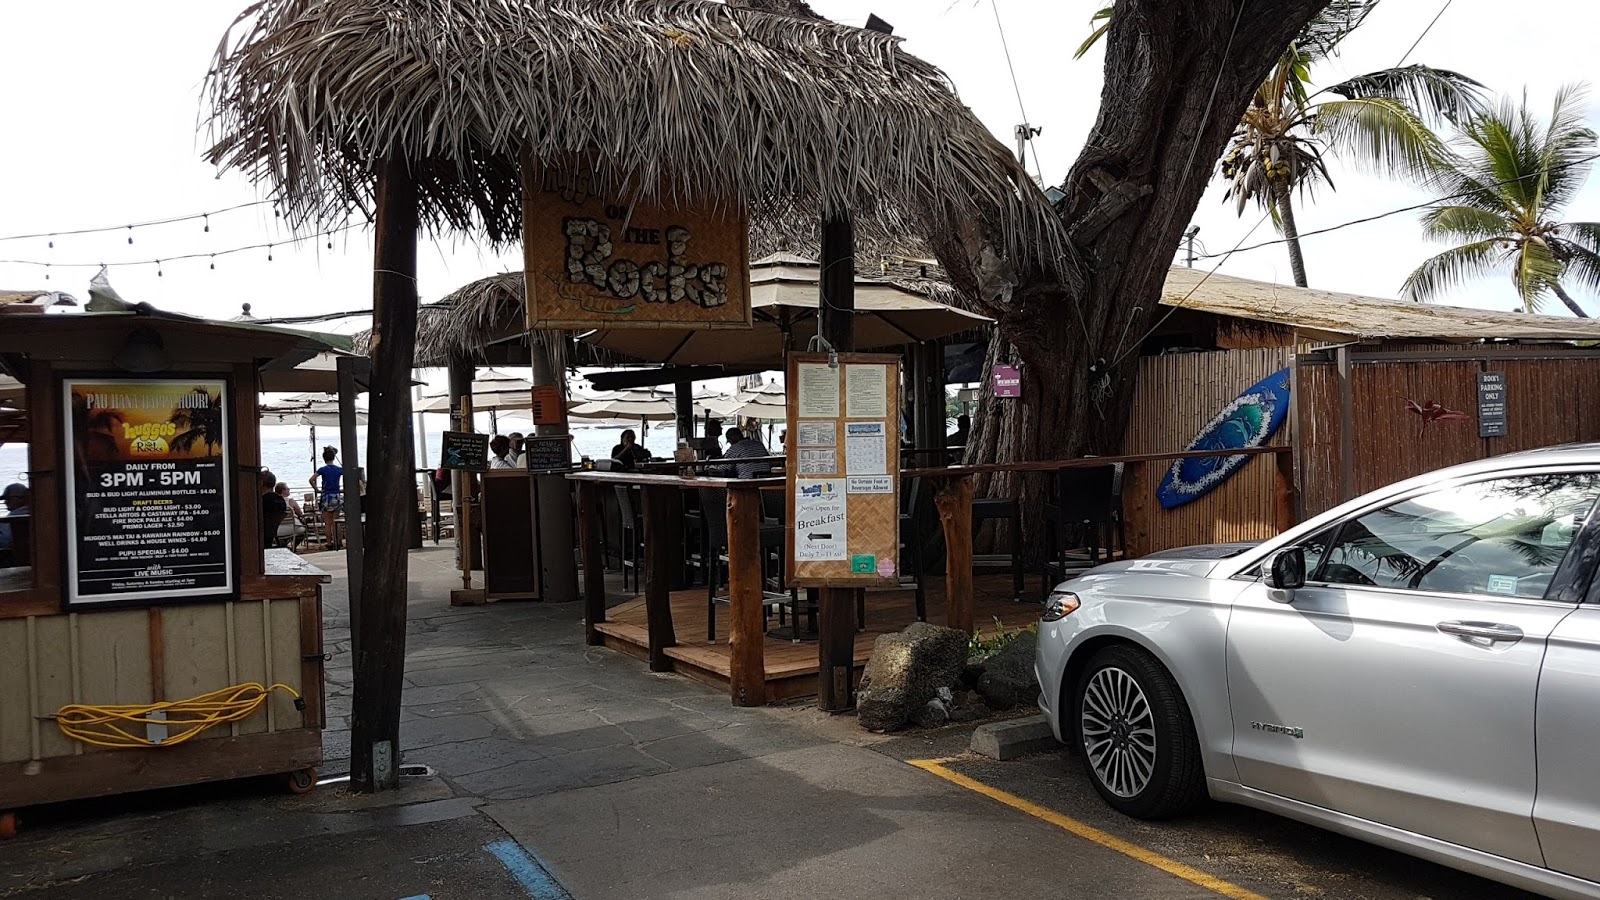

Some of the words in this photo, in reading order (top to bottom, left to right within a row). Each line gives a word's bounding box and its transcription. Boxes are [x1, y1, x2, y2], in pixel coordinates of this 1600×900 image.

[624, 228, 660, 244] THE
[562, 216, 730, 307] Rocks
[86, 393, 108, 409] PAU
[111, 393, 138, 409] HANA
[142, 393, 174, 409] HAPPY
[178, 393, 209, 409] HOUR!
[137, 441, 163, 453] Rocks
[100, 472, 144, 487] 3PM
[160, 471, 201, 486] 5PM
[797, 512, 845, 530] Breakfast
[147, 563, 162, 571] with
